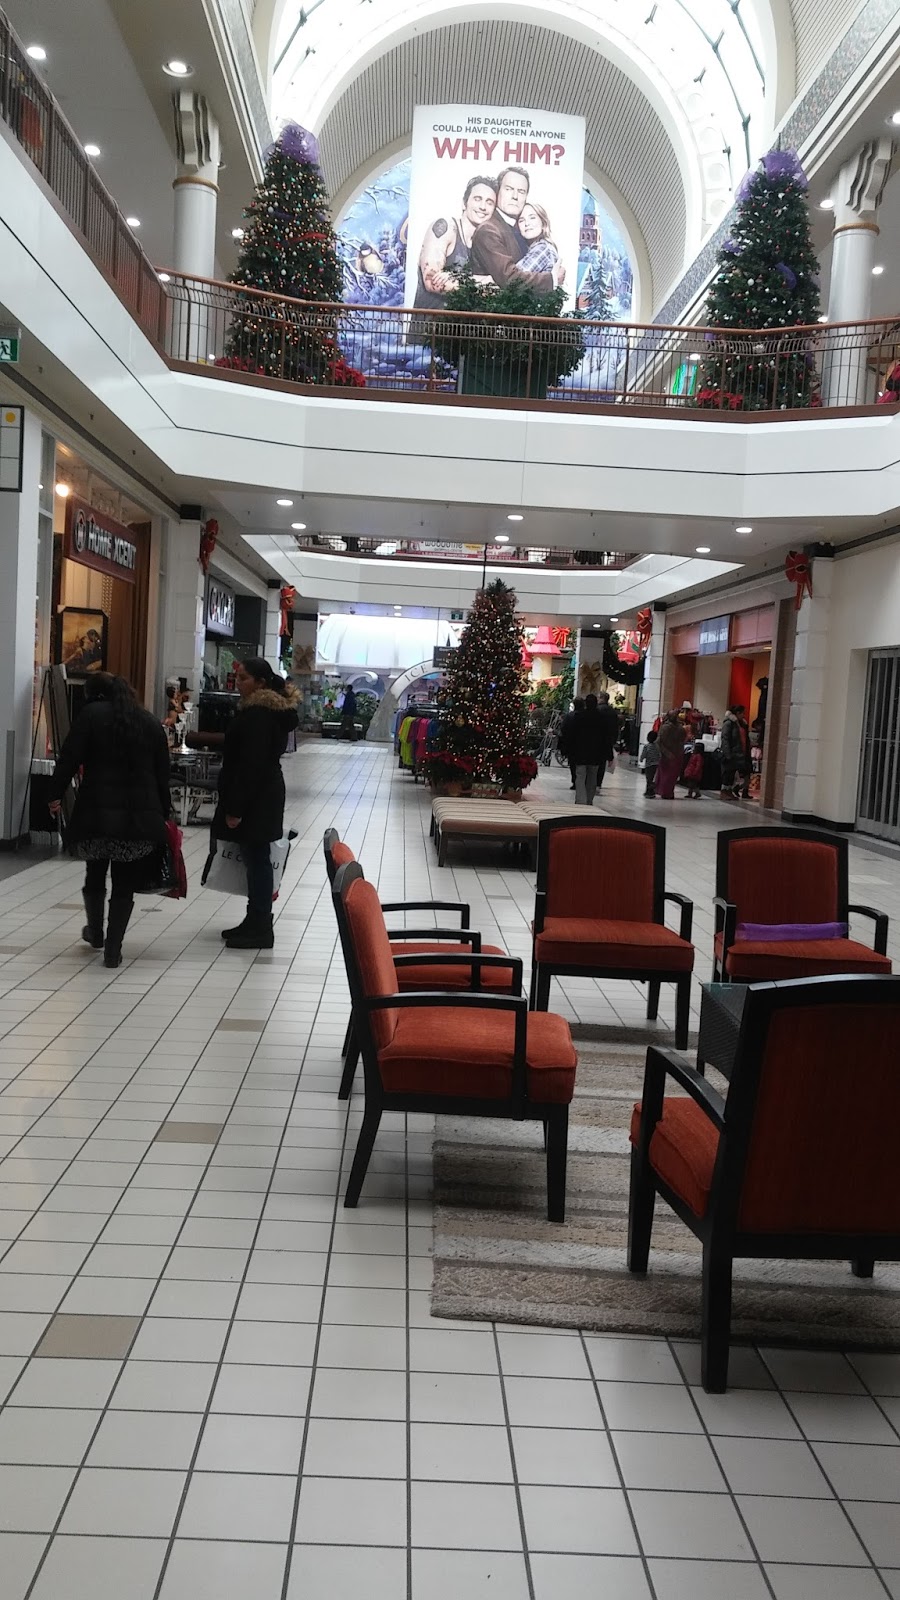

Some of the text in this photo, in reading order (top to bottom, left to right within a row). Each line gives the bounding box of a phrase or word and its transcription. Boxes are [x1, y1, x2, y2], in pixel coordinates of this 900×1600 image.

[467, 117, 532, 128] HIS DAUGHTER
[432, 124, 566, 140] COULD HAVE CHOSEN ANYONE
[432, 137, 566, 166] WHY HIM?
[88, 516, 137, 570] HOME XCENT
[404, 664, 428, 682] ICE
[222, 849, 233, 859] LE
